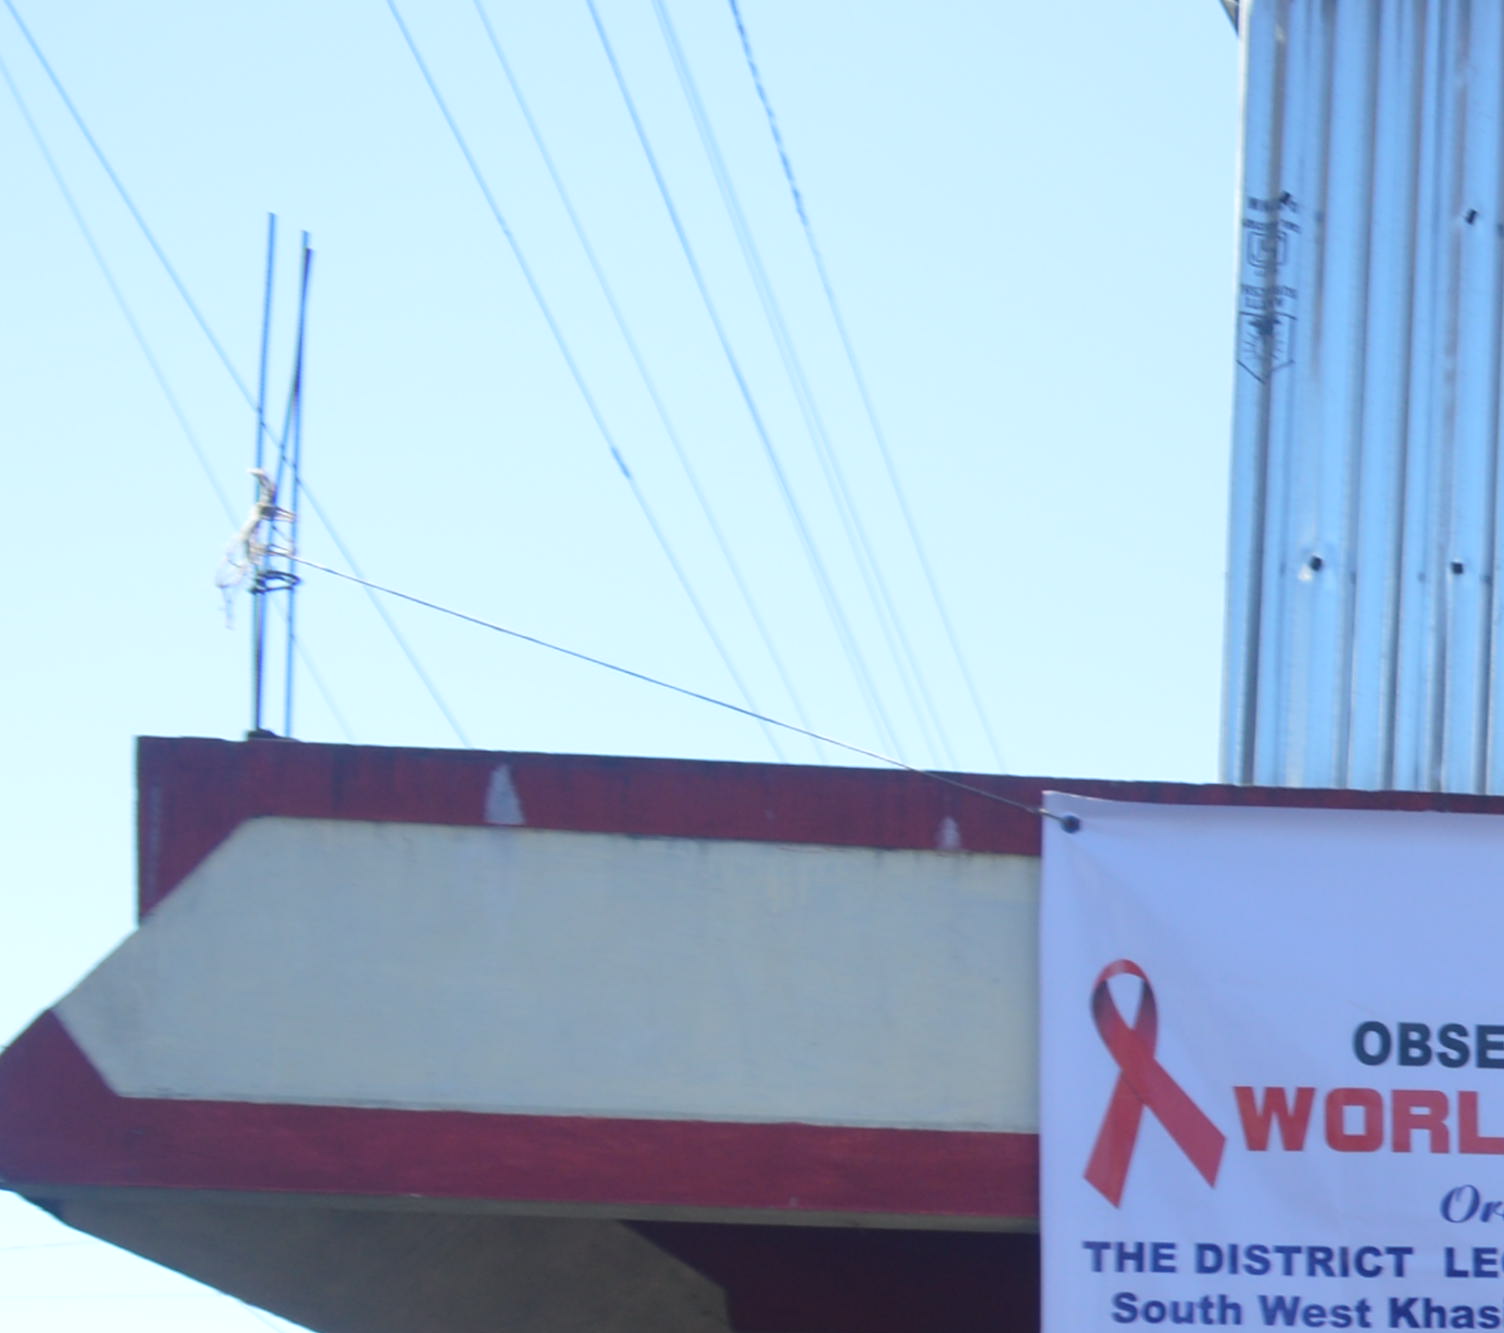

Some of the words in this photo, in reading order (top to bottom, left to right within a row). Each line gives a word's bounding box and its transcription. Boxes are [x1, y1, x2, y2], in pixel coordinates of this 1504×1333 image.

[1083, 1241, 1177, 1273] THE
[1196, 1243, 1414, 1278] DISTRICT
[1112, 1292, 1242, 1325] South
[1258, 1295, 1372, 1328] West
